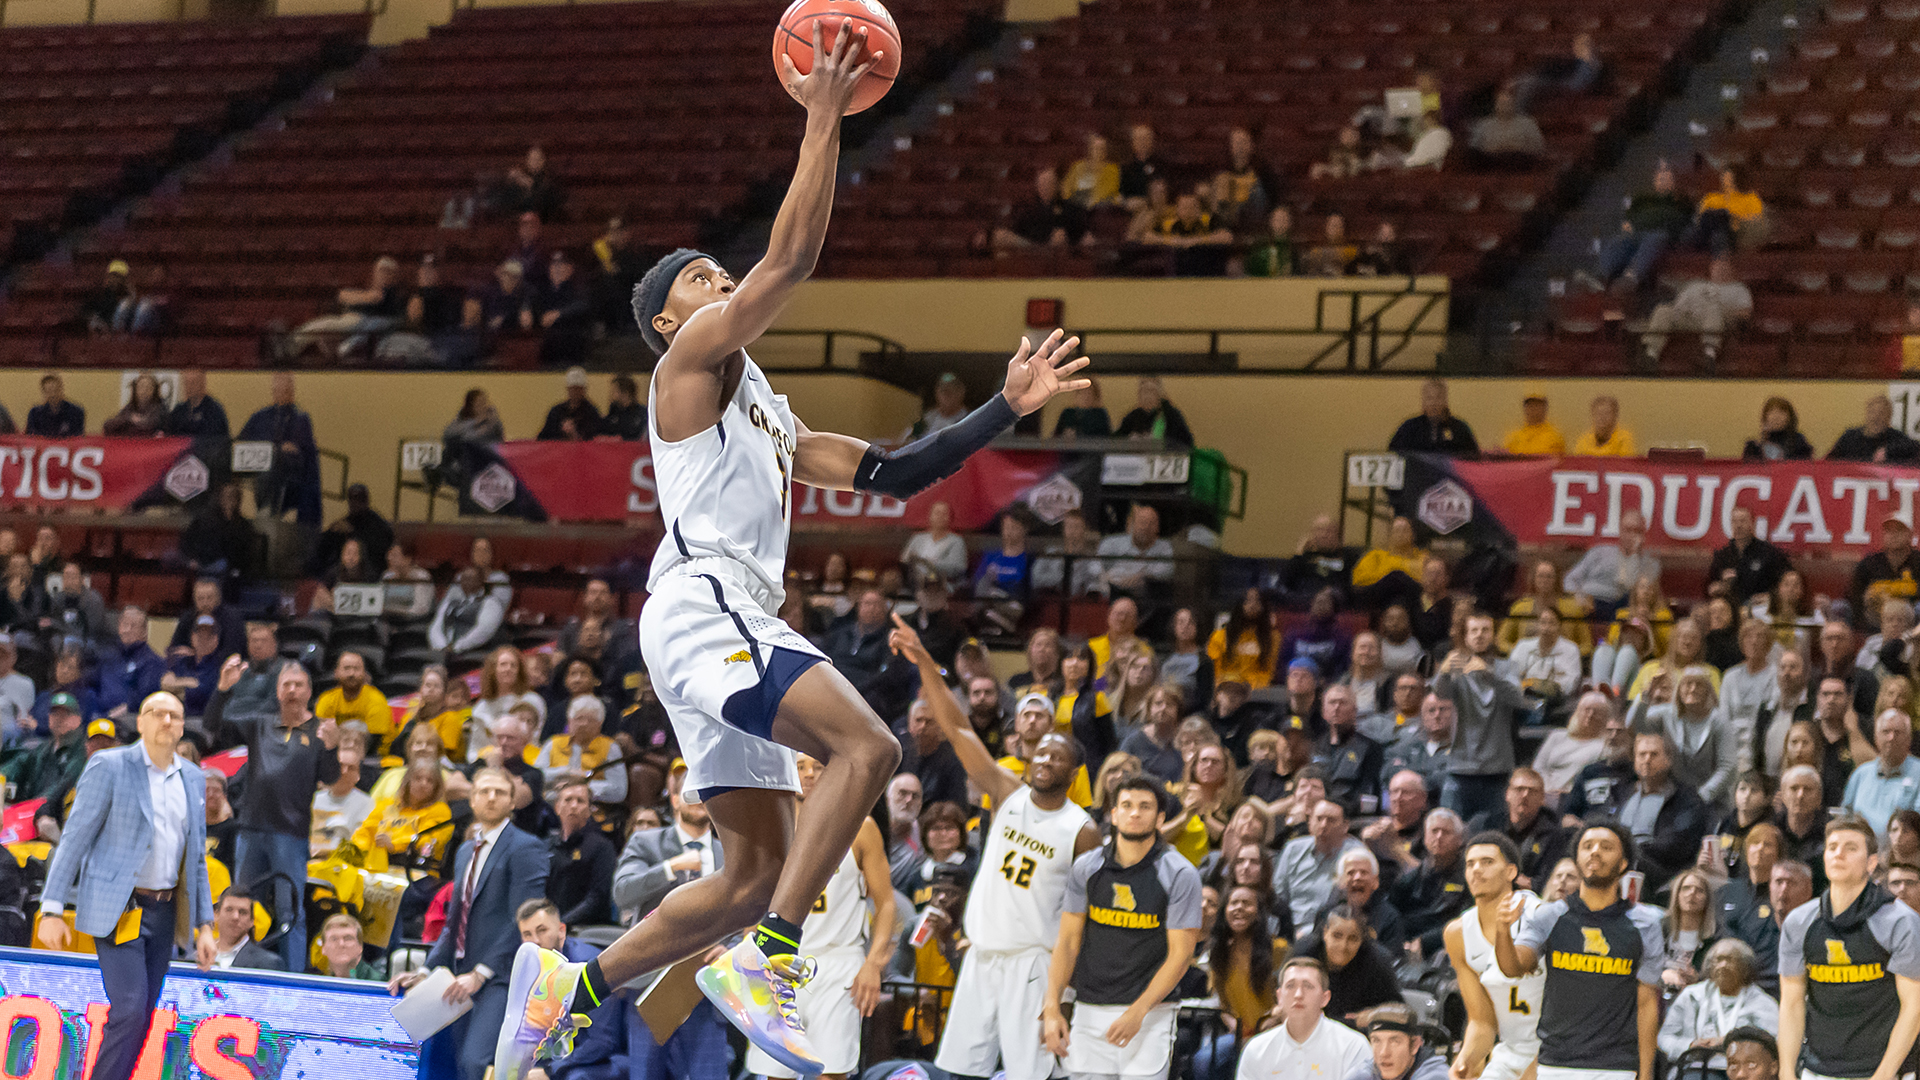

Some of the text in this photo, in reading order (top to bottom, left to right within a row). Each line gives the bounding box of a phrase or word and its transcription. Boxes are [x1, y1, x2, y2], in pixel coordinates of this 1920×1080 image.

[1149, 456, 1189, 481] 128
[1354, 459, 1393, 483] 127
[999, 849, 1037, 890] 42
[1552, 950, 1633, 976] BASKETBALL
[1509, 985, 1531, 1016] 4
